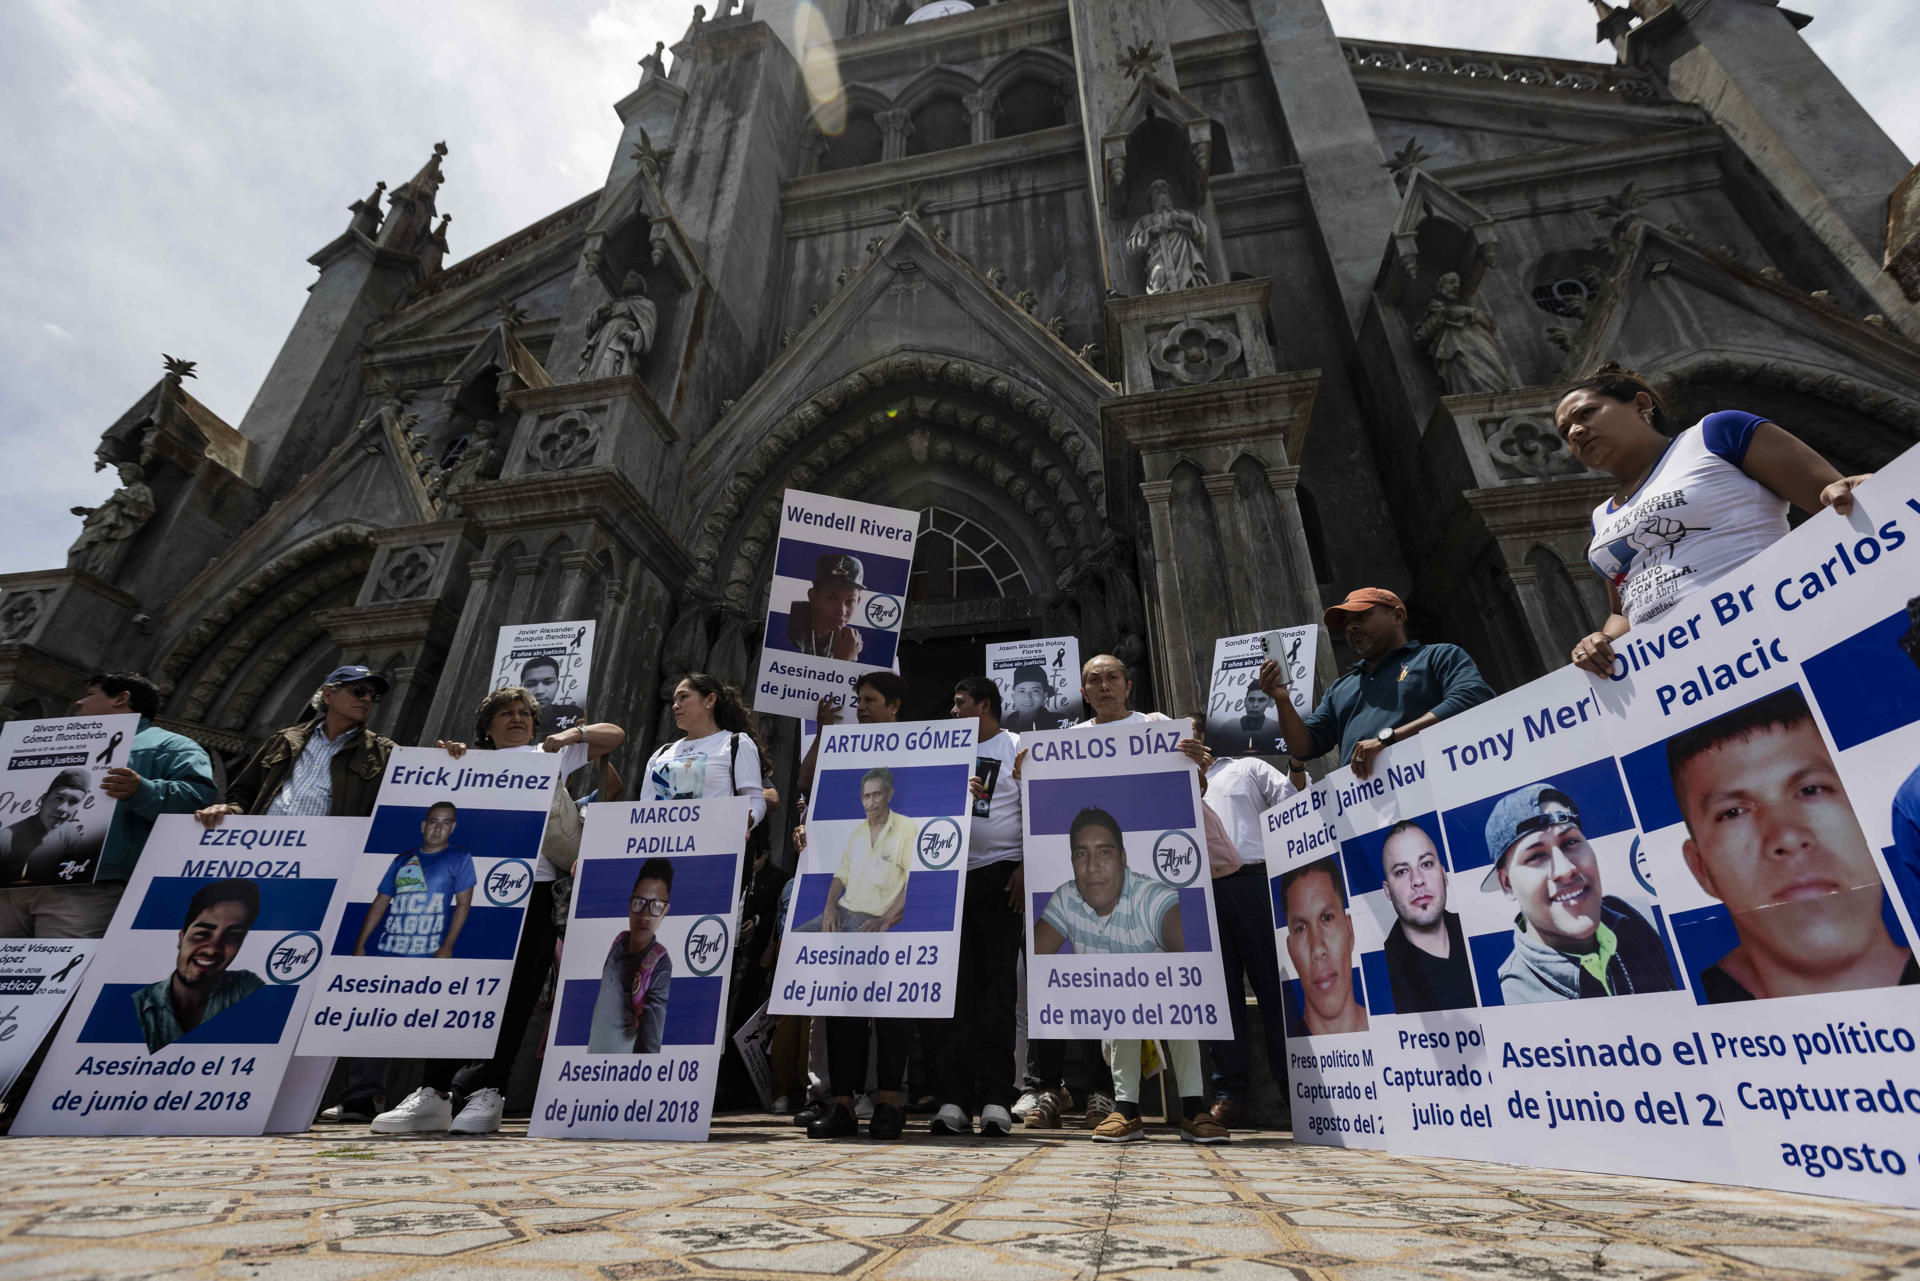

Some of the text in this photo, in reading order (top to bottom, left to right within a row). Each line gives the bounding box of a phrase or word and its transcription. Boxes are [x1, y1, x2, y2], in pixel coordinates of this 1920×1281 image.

[1634, 498, 1689, 521] PATRIA
[787, 505, 913, 543] Wendell Rivera
[1774, 519, 1907, 612] Carlos
[1631, 581, 1652, 597] CON
[1656, 565, 1697, 585] ELLA.
[1608, 613, 1701, 682] Oliver
[769, 661, 844, 684] Asesinado
[761, 681, 778, 695] de
[780, 684, 820, 702] junio
[823, 692, 846, 706] del
[66, 722, 103, 731] Alberto
[1442, 687, 1601, 772] Tony Mer
[23, 735, 53, 744] Gómez
[824, 726, 972, 754] ARTURO GÓMEZ
[1031, 728, 1181, 762] CARLOS DÍAZ
[18, 758, 38, 767] años
[40, 757, 52, 765] sin
[52, 755, 85, 766] justicia
[391, 766, 550, 791] Erick Jiménez
[1335, 777, 1385, 816] Jaime
[630, 805, 701, 824] MARCOS
[1267, 799, 1309, 832] Evertz
[199, 829, 307, 847] EZEQUIEL
[626, 835, 696, 854] PADILLA
[180, 860, 301, 878] MENDOZA
[28, 943, 74, 955] Vásquez
[796, 945, 938, 966] Asesinado el 23
[327, 974, 501, 996] Asesinado el 17
[1048, 966, 1202, 988] Asesinado el 30
[48, 986, 67, 995] años
[783, 980, 942, 1007] de junio del 2018
[314, 1006, 496, 1032] de julio del 2018
[1039, 1003, 1218, 1031] de mayo del 2018
[1398, 1030, 1450, 1049] Preso
[1502, 1032, 1708, 1068] Asesinado el
[1711, 1021, 1915, 1065] Preso político
[76, 1056, 256, 1076] Asesinado el 14
[558, 1059, 700, 1082] Asesinado el 08
[1291, 1053, 1318, 1069] Preso
[1320, 1050, 1360, 1073] político
[1383, 1064, 1482, 1092] Capturado
[51, 1091, 251, 1116] de junio del 2018
[1296, 1080, 1377, 1104] Capturado el
[1737, 1080, 1920, 1119] Capturado
[544, 1098, 700, 1128] de junio del 2018
[1412, 1103, 1455, 1130] julio
[1460, 1103, 1492, 1128] del
[1508, 1090, 1540, 1119] de
[1545, 1090, 1625, 1129] junio
[1634, 1091, 1689, 1126] del
[1309, 1115, 1350, 1135] agosto
[1354, 1114, 1375, 1134] del
[1781, 1143, 1906, 1178] agosto
